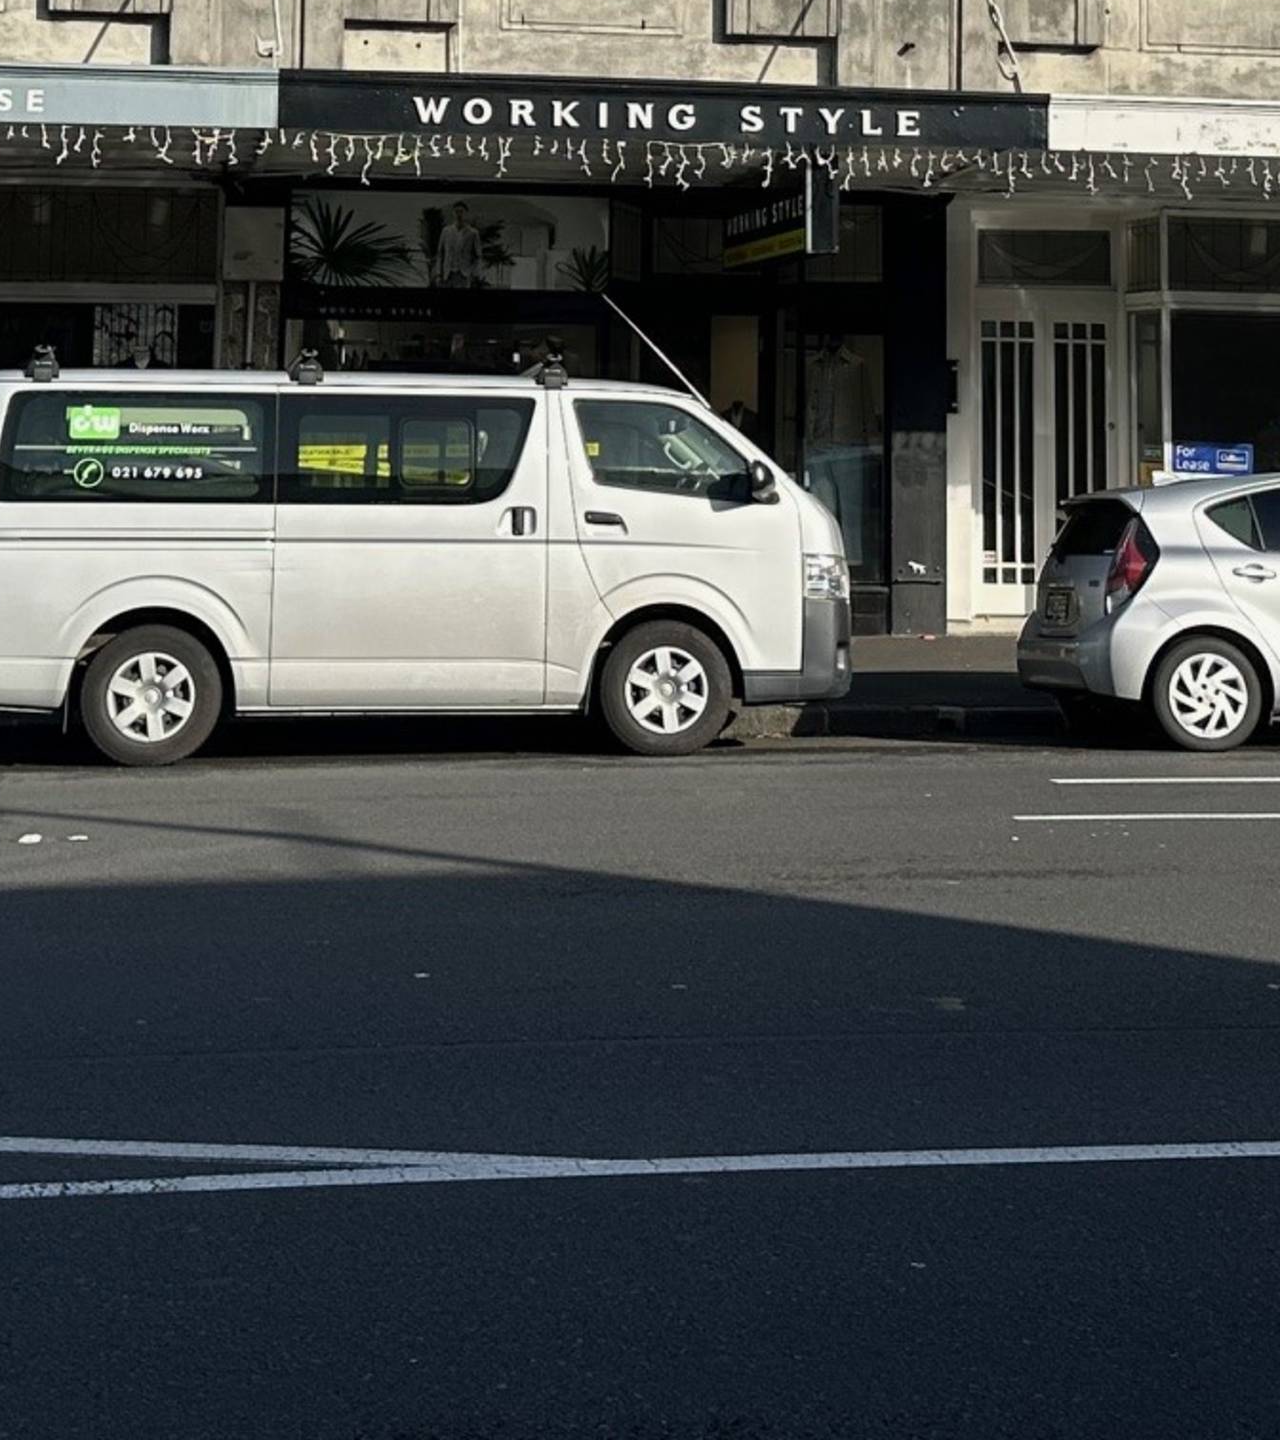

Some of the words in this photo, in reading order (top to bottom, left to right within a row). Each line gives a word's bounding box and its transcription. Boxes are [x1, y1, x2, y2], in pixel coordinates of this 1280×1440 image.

[413, 96, 697, 130] WORKING
[740, 105, 921, 137] STYLE
[129, 422, 179, 436] Dispense
[1176, 446, 1196, 458] For
[1176, 459, 1210, 471] Lease
[112, 467, 138, 478] 021
[144, 467, 171, 479] 679
[175, 467, 203, 479] 695
